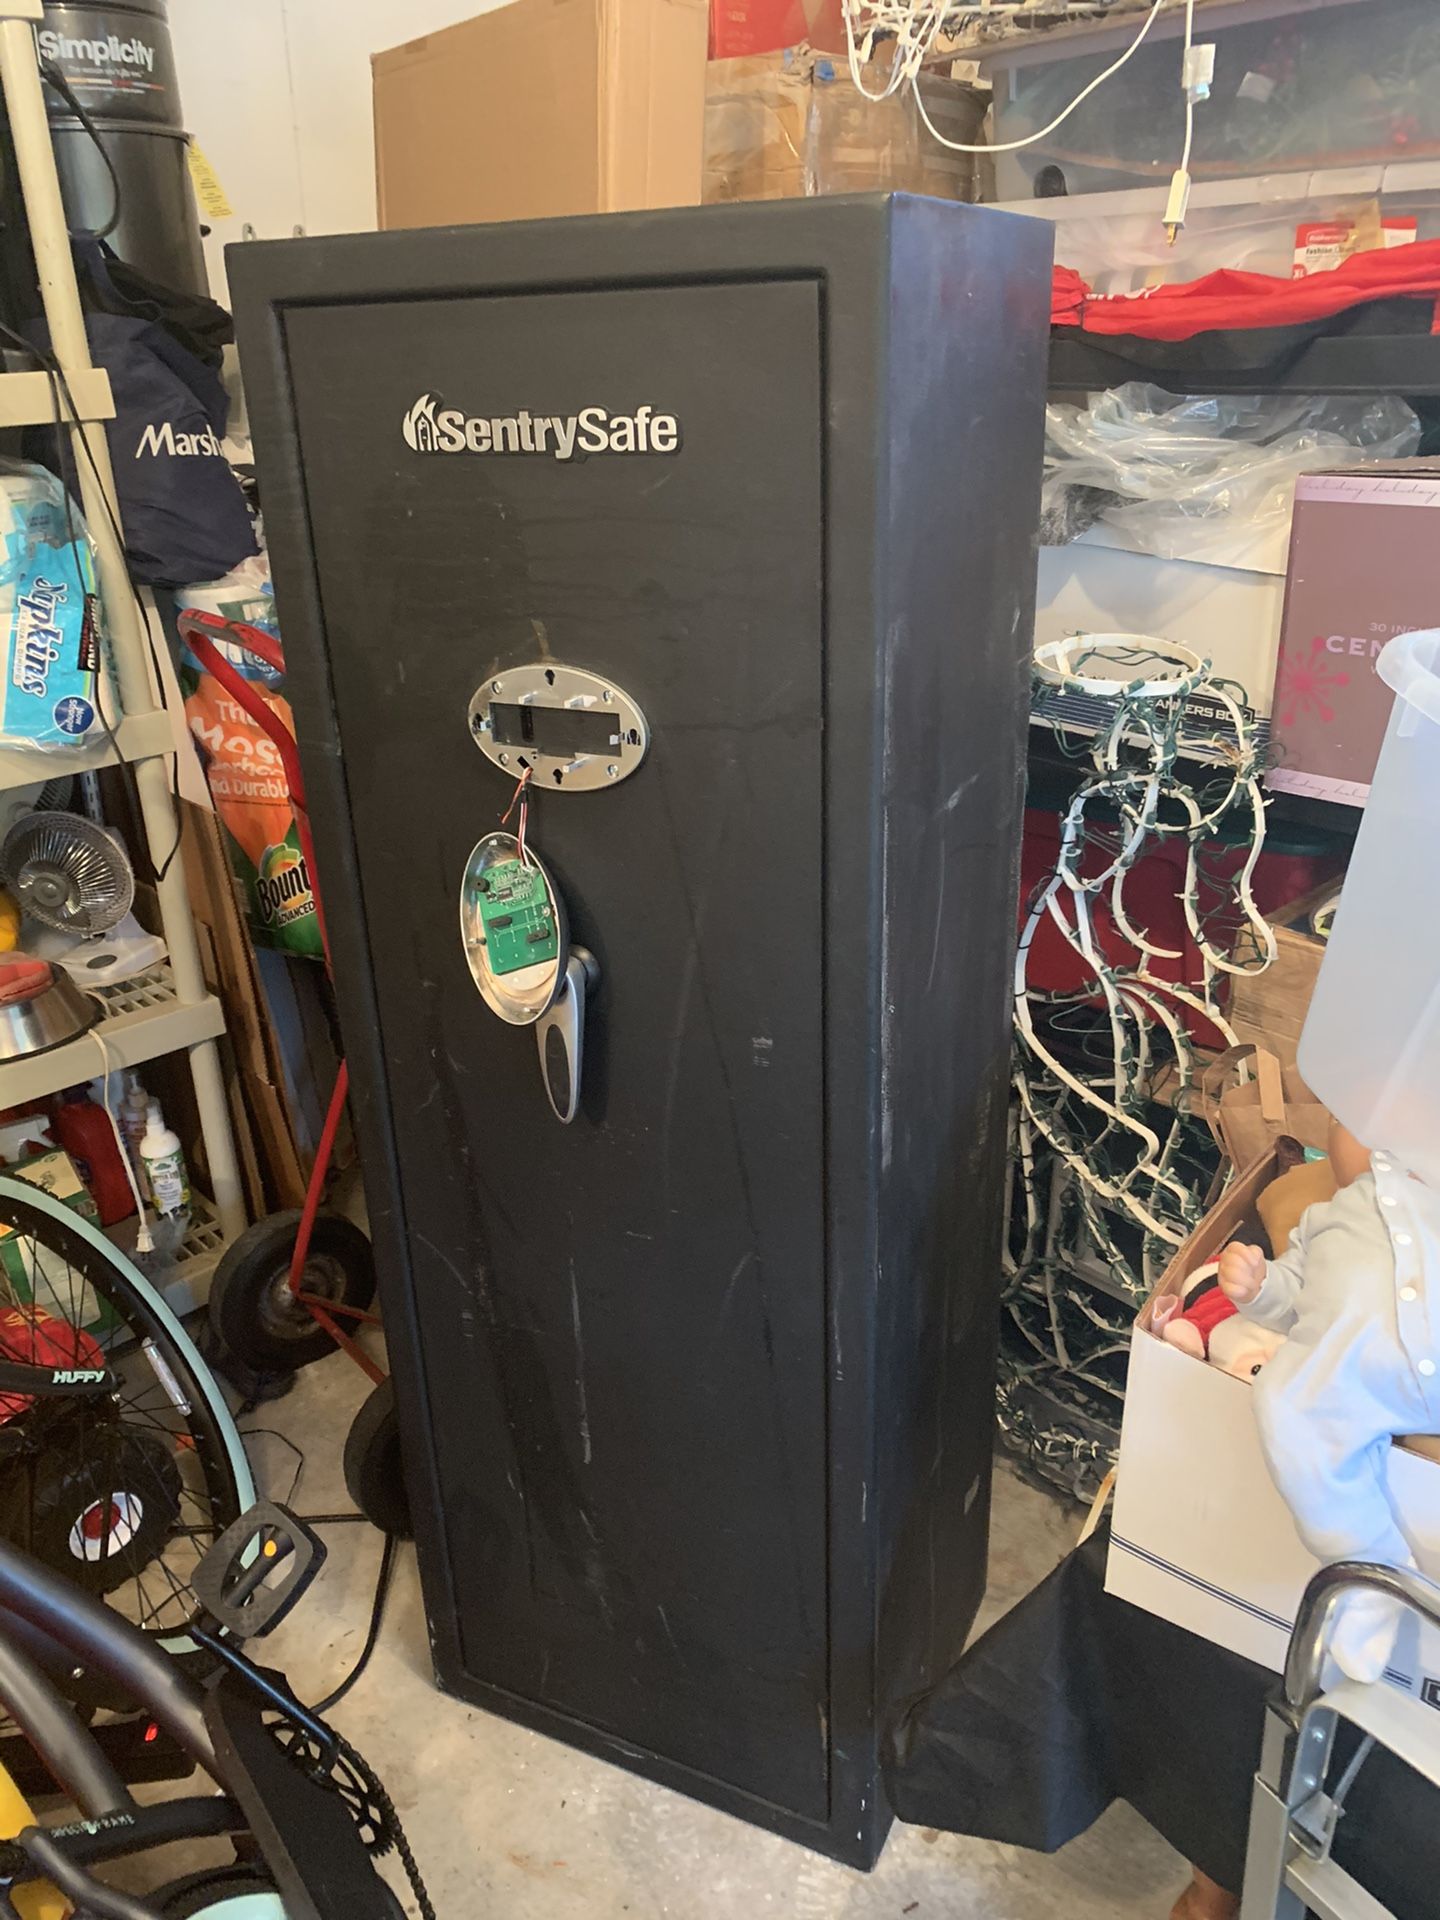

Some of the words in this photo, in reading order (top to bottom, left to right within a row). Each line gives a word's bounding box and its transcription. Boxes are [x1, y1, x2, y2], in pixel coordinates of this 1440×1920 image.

[39, 30, 154, 72] Simplicity
[437, 406, 678, 459] SentrySafe
[18, 576, 67, 698] Napkins
[1325, 635, 1384, 658] CEN
[1369, 622, 1387, 632] 30
[1391, 625, 1422, 634] INC
[190, 716, 285, 766] Mos
[256, 857, 312, 922] Bount
[278, 900, 316, 926] ADVANCED
[52, 1371, 105, 1384] HUFFY
